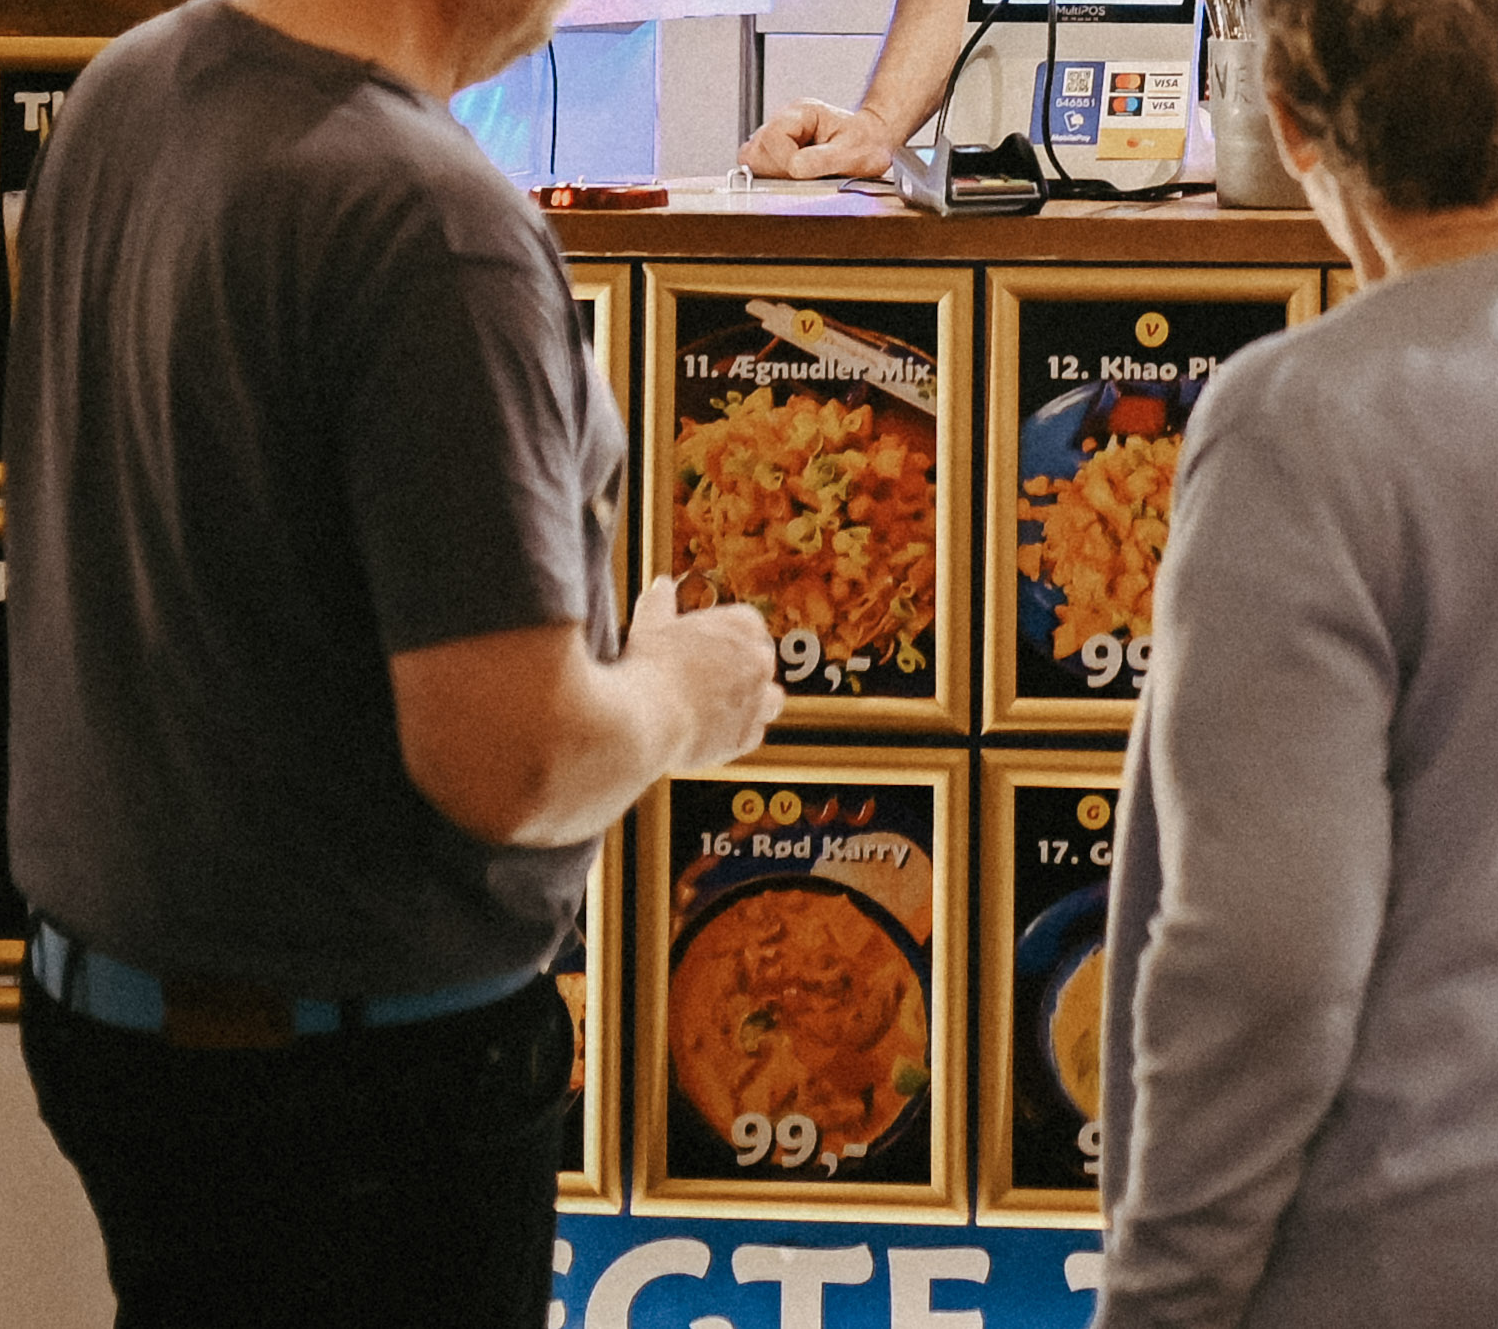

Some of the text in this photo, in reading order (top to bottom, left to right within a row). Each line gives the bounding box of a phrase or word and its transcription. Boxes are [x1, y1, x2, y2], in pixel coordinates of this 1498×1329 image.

[1154, 78, 1179, 88] VISA
[1152, 101, 1175, 110] VISA
[683, 355, 932, 387] 11. Ægnudler Mix
[1047, 356, 1179, 382] 12. Khao
[701, 832, 909, 870] 16. Rød Karry
[1038, 840, 1079, 865] 17.
[731, 1113, 868, 1177] 99,-
